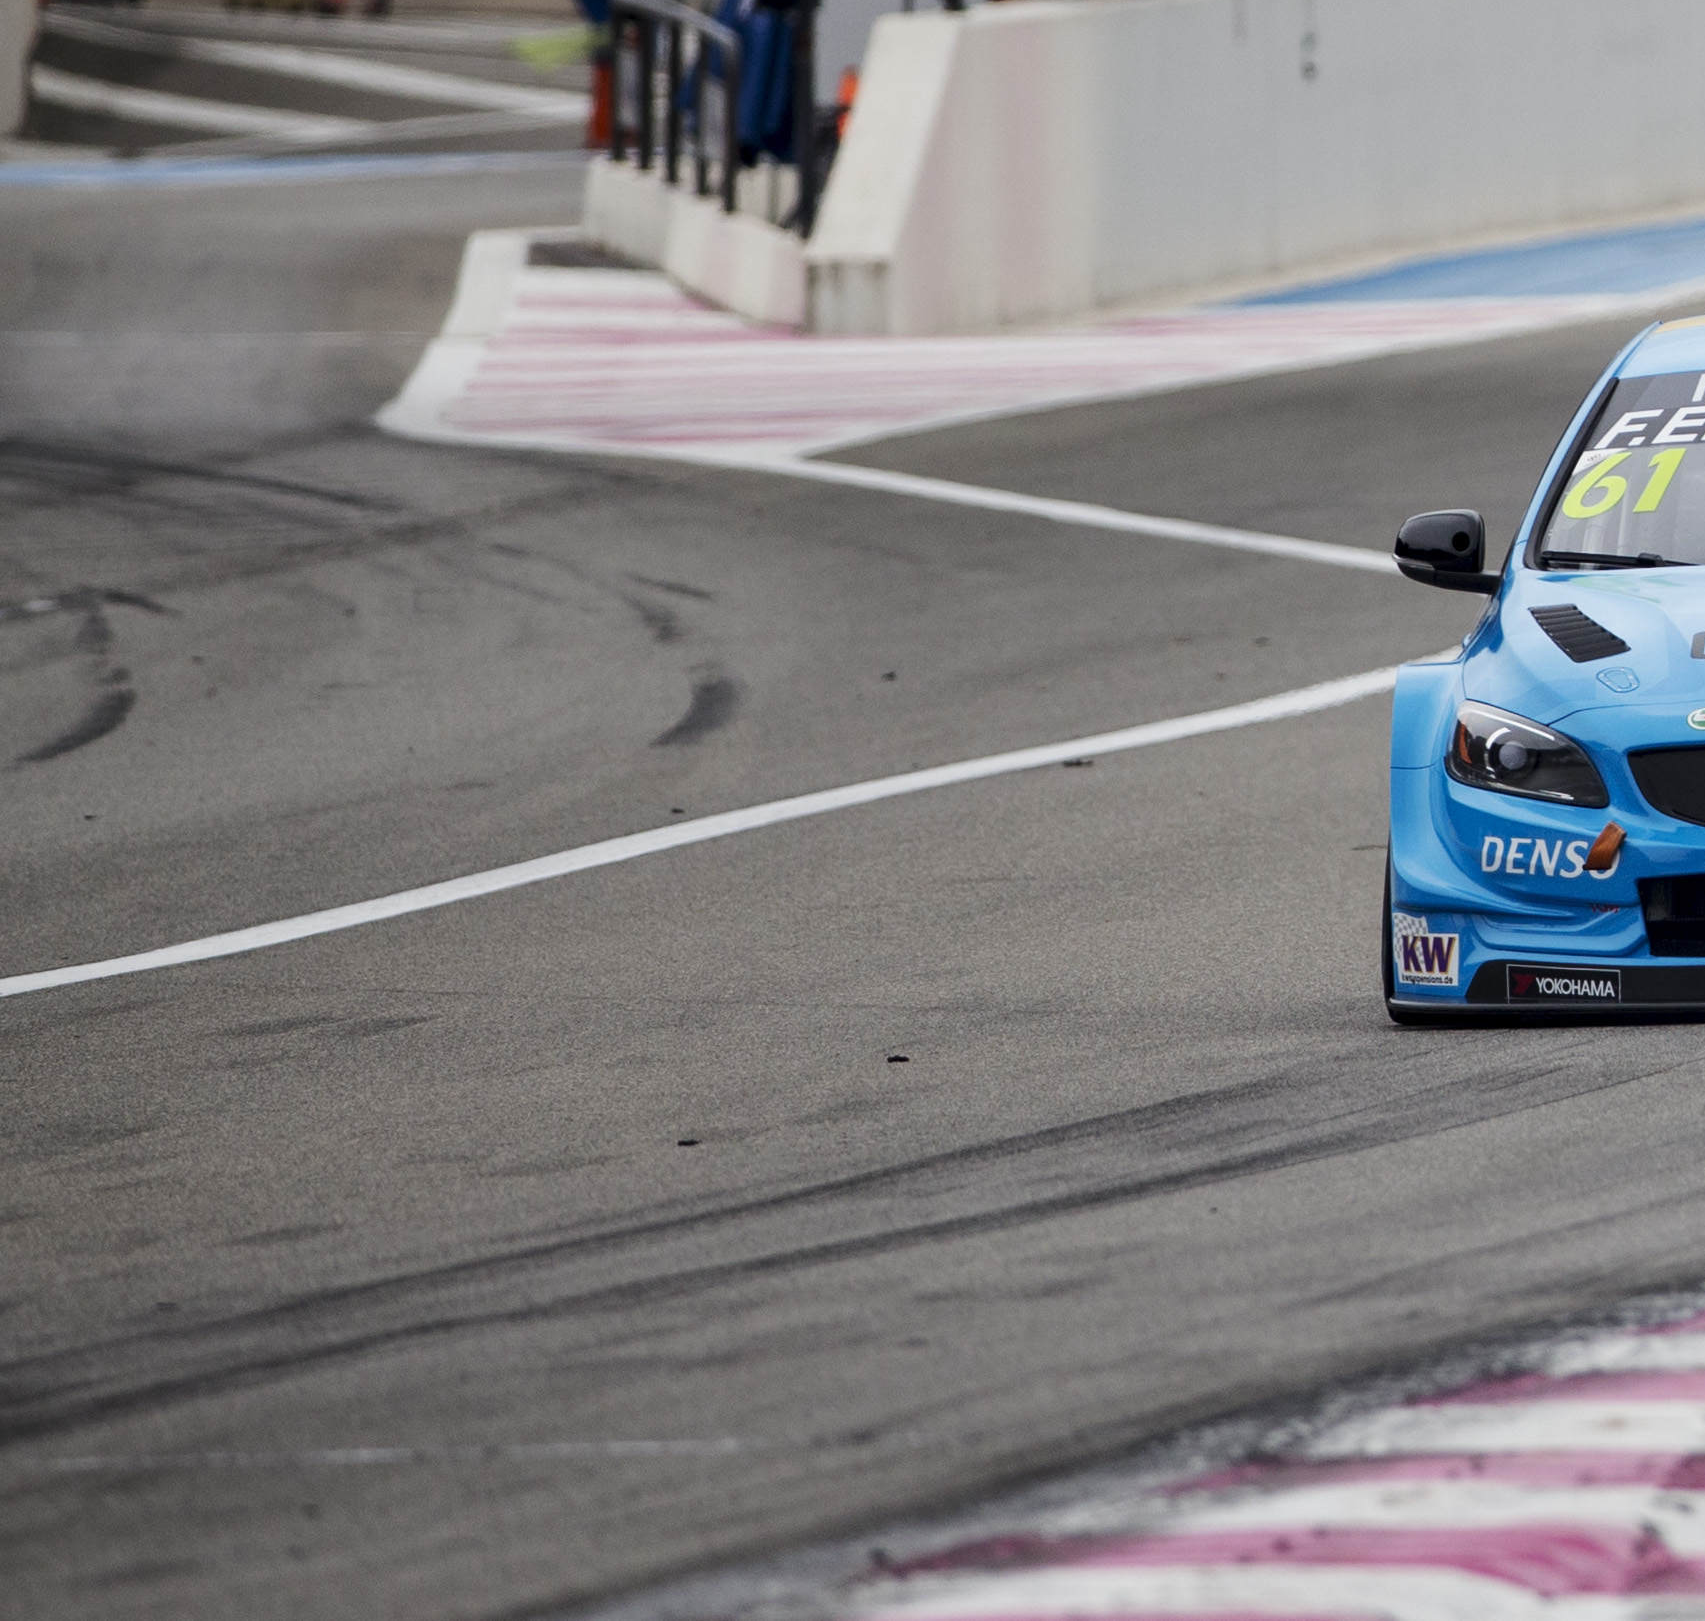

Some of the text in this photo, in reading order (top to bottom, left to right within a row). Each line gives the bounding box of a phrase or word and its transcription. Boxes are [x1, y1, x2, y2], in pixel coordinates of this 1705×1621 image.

[1562, 447, 1687, 519] 61
[1402, 935, 1457, 974] KW
[1535, 976, 1616, 997] YOKOHAMA
